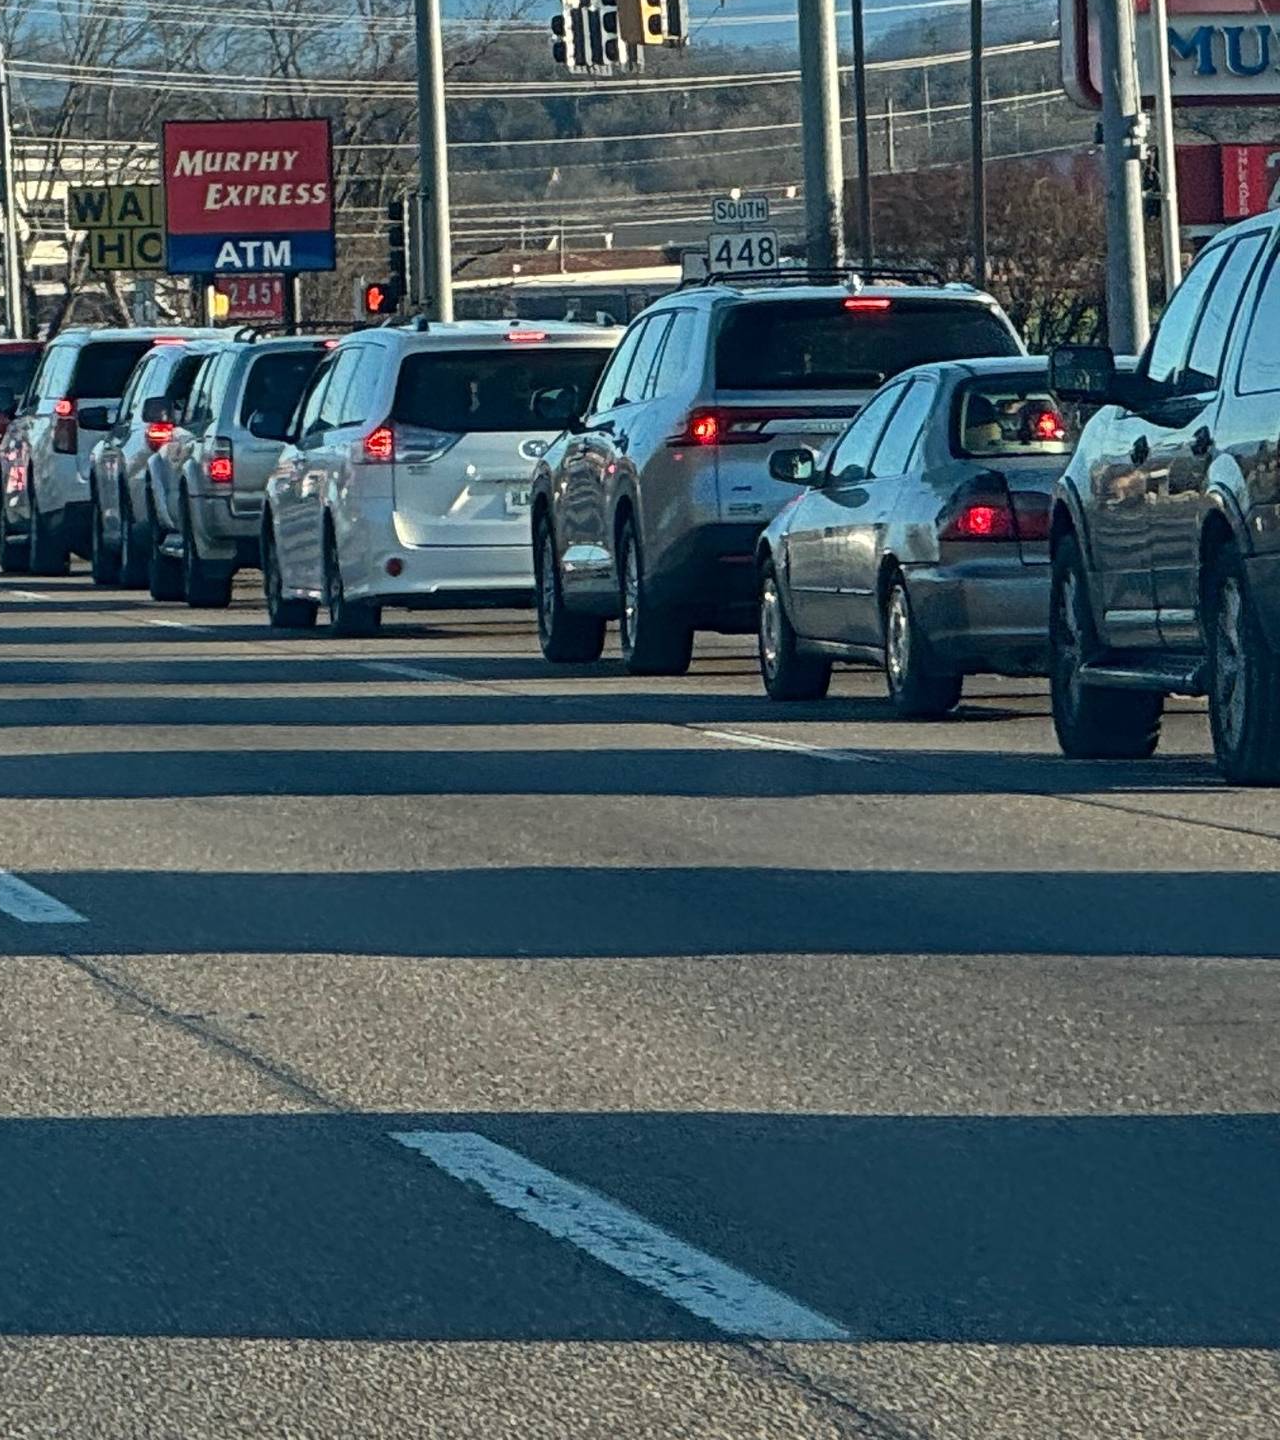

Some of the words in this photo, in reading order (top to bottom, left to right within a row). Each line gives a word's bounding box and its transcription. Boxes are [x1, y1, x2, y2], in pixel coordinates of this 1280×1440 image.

[1167, 24, 1280, 76] MU
[173, 150, 299, 177] MURPHY
[204, 183, 327, 210] EXPRESS
[716, 201, 766, 219] SOUTH
[215, 240, 292, 268] ATM
[715, 237, 775, 270] 448
